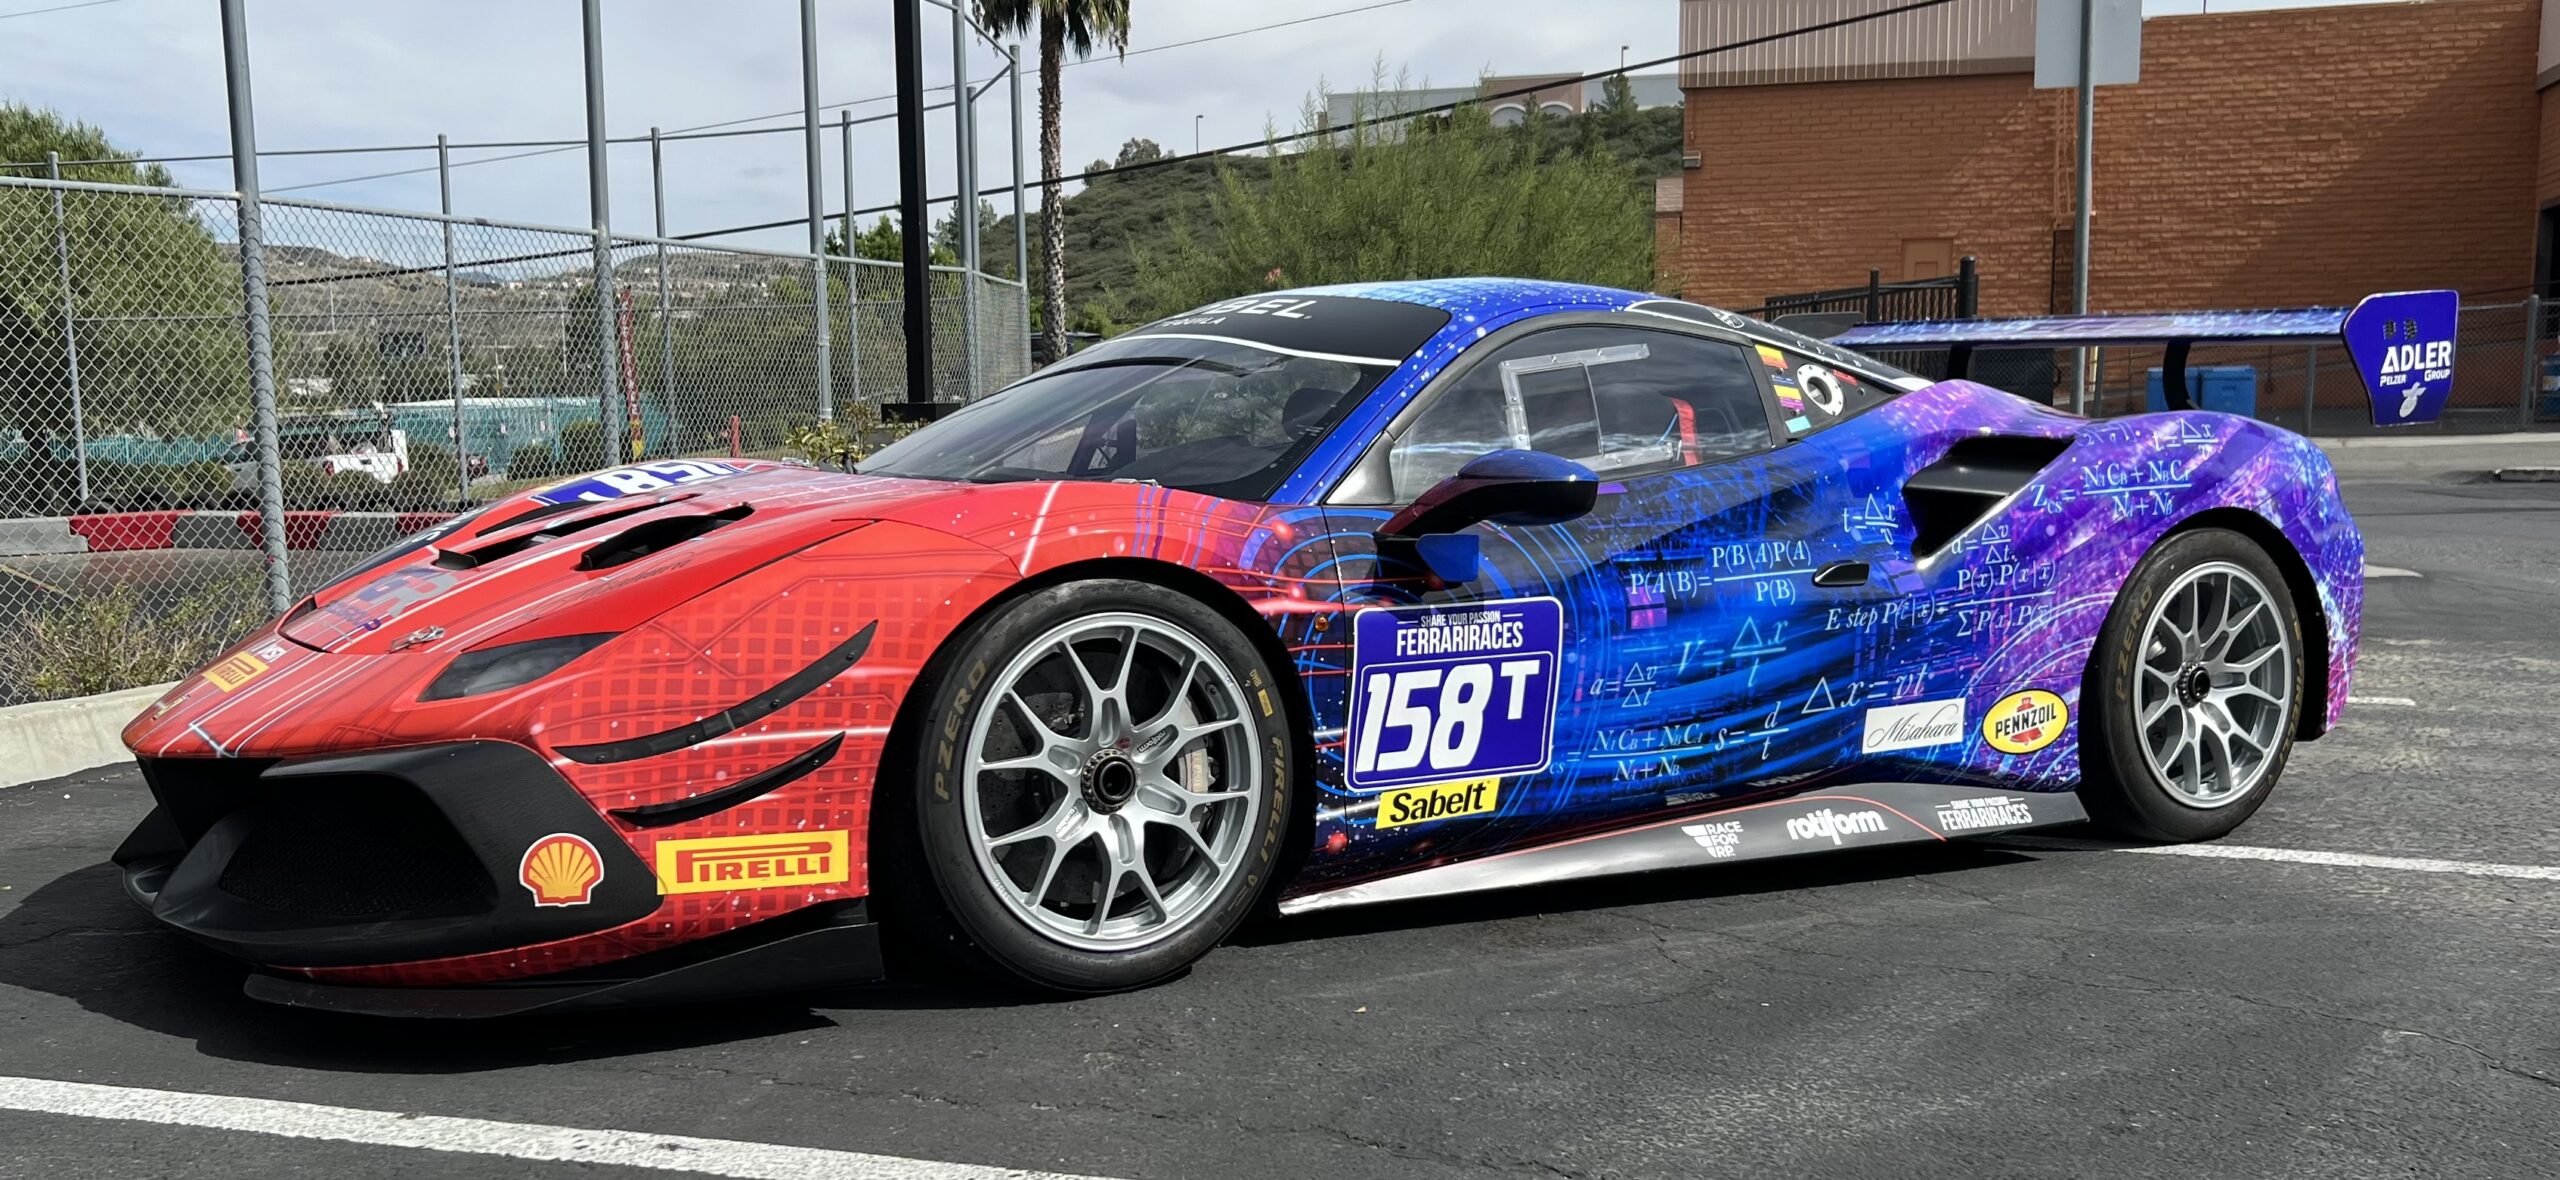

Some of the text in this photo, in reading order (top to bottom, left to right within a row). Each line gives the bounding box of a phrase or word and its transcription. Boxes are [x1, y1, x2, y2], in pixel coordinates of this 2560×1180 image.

[2380, 340, 2452, 374] ADLER
[1421, 610, 1501, 627] SHARE YOUR PASSION
[1396, 621, 1523, 656] FERRARIRACES
[1866, 703, 1959, 748] Misahara
[1995, 702, 2057, 740] PENNZOIL
[1261, 736, 1285, 862] PIRELLI
[1389, 781, 1487, 823] Sabelt
[1937, 803, 2033, 830] FERRARIRACES
[1707, 821, 1743, 835] RACE
[1711, 833, 1739, 846] FOR
[1786, 808, 1889, 846] rotiform
[676, 841, 832, 884] PIRELLI
